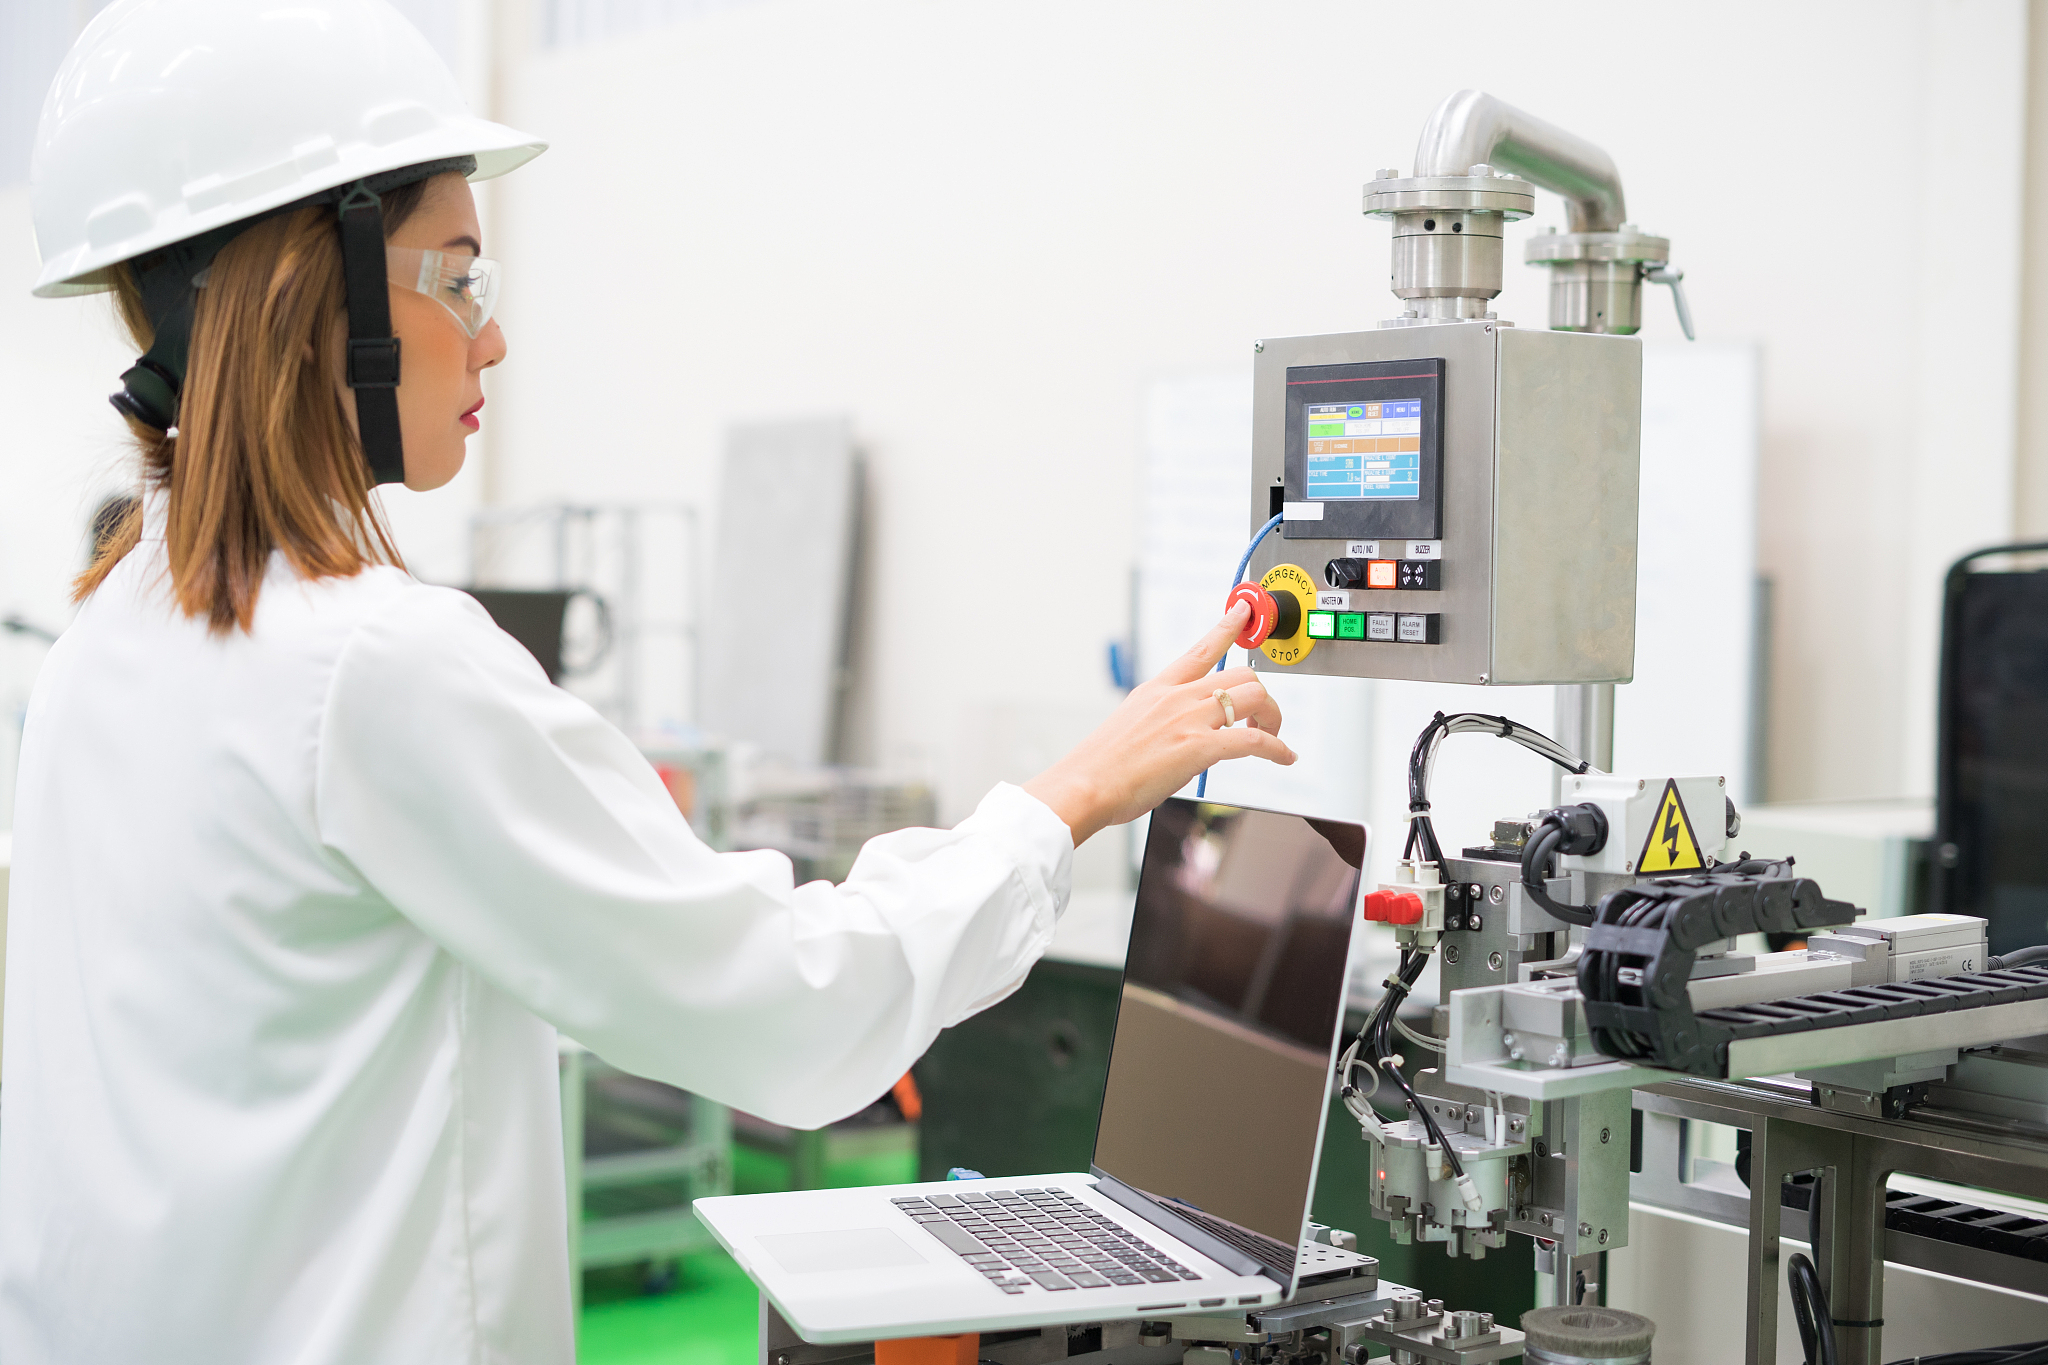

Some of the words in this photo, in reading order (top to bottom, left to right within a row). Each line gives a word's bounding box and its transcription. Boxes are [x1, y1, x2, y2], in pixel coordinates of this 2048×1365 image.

[1351, 545, 1362, 554] AUTO
[1415, 545, 1431, 554] BUZZER
[1374, 566, 1389, 574] AUTO
[1261, 568, 1312, 595] MERGENCY
[1321, 596, 1336, 605] MASTER
[1336, 596, 1343, 606] ON
[1372, 627, 1389, 635] RESET
[1270, 648, 1300, 661] STOP
[1962, 959, 1972, 972] CE
